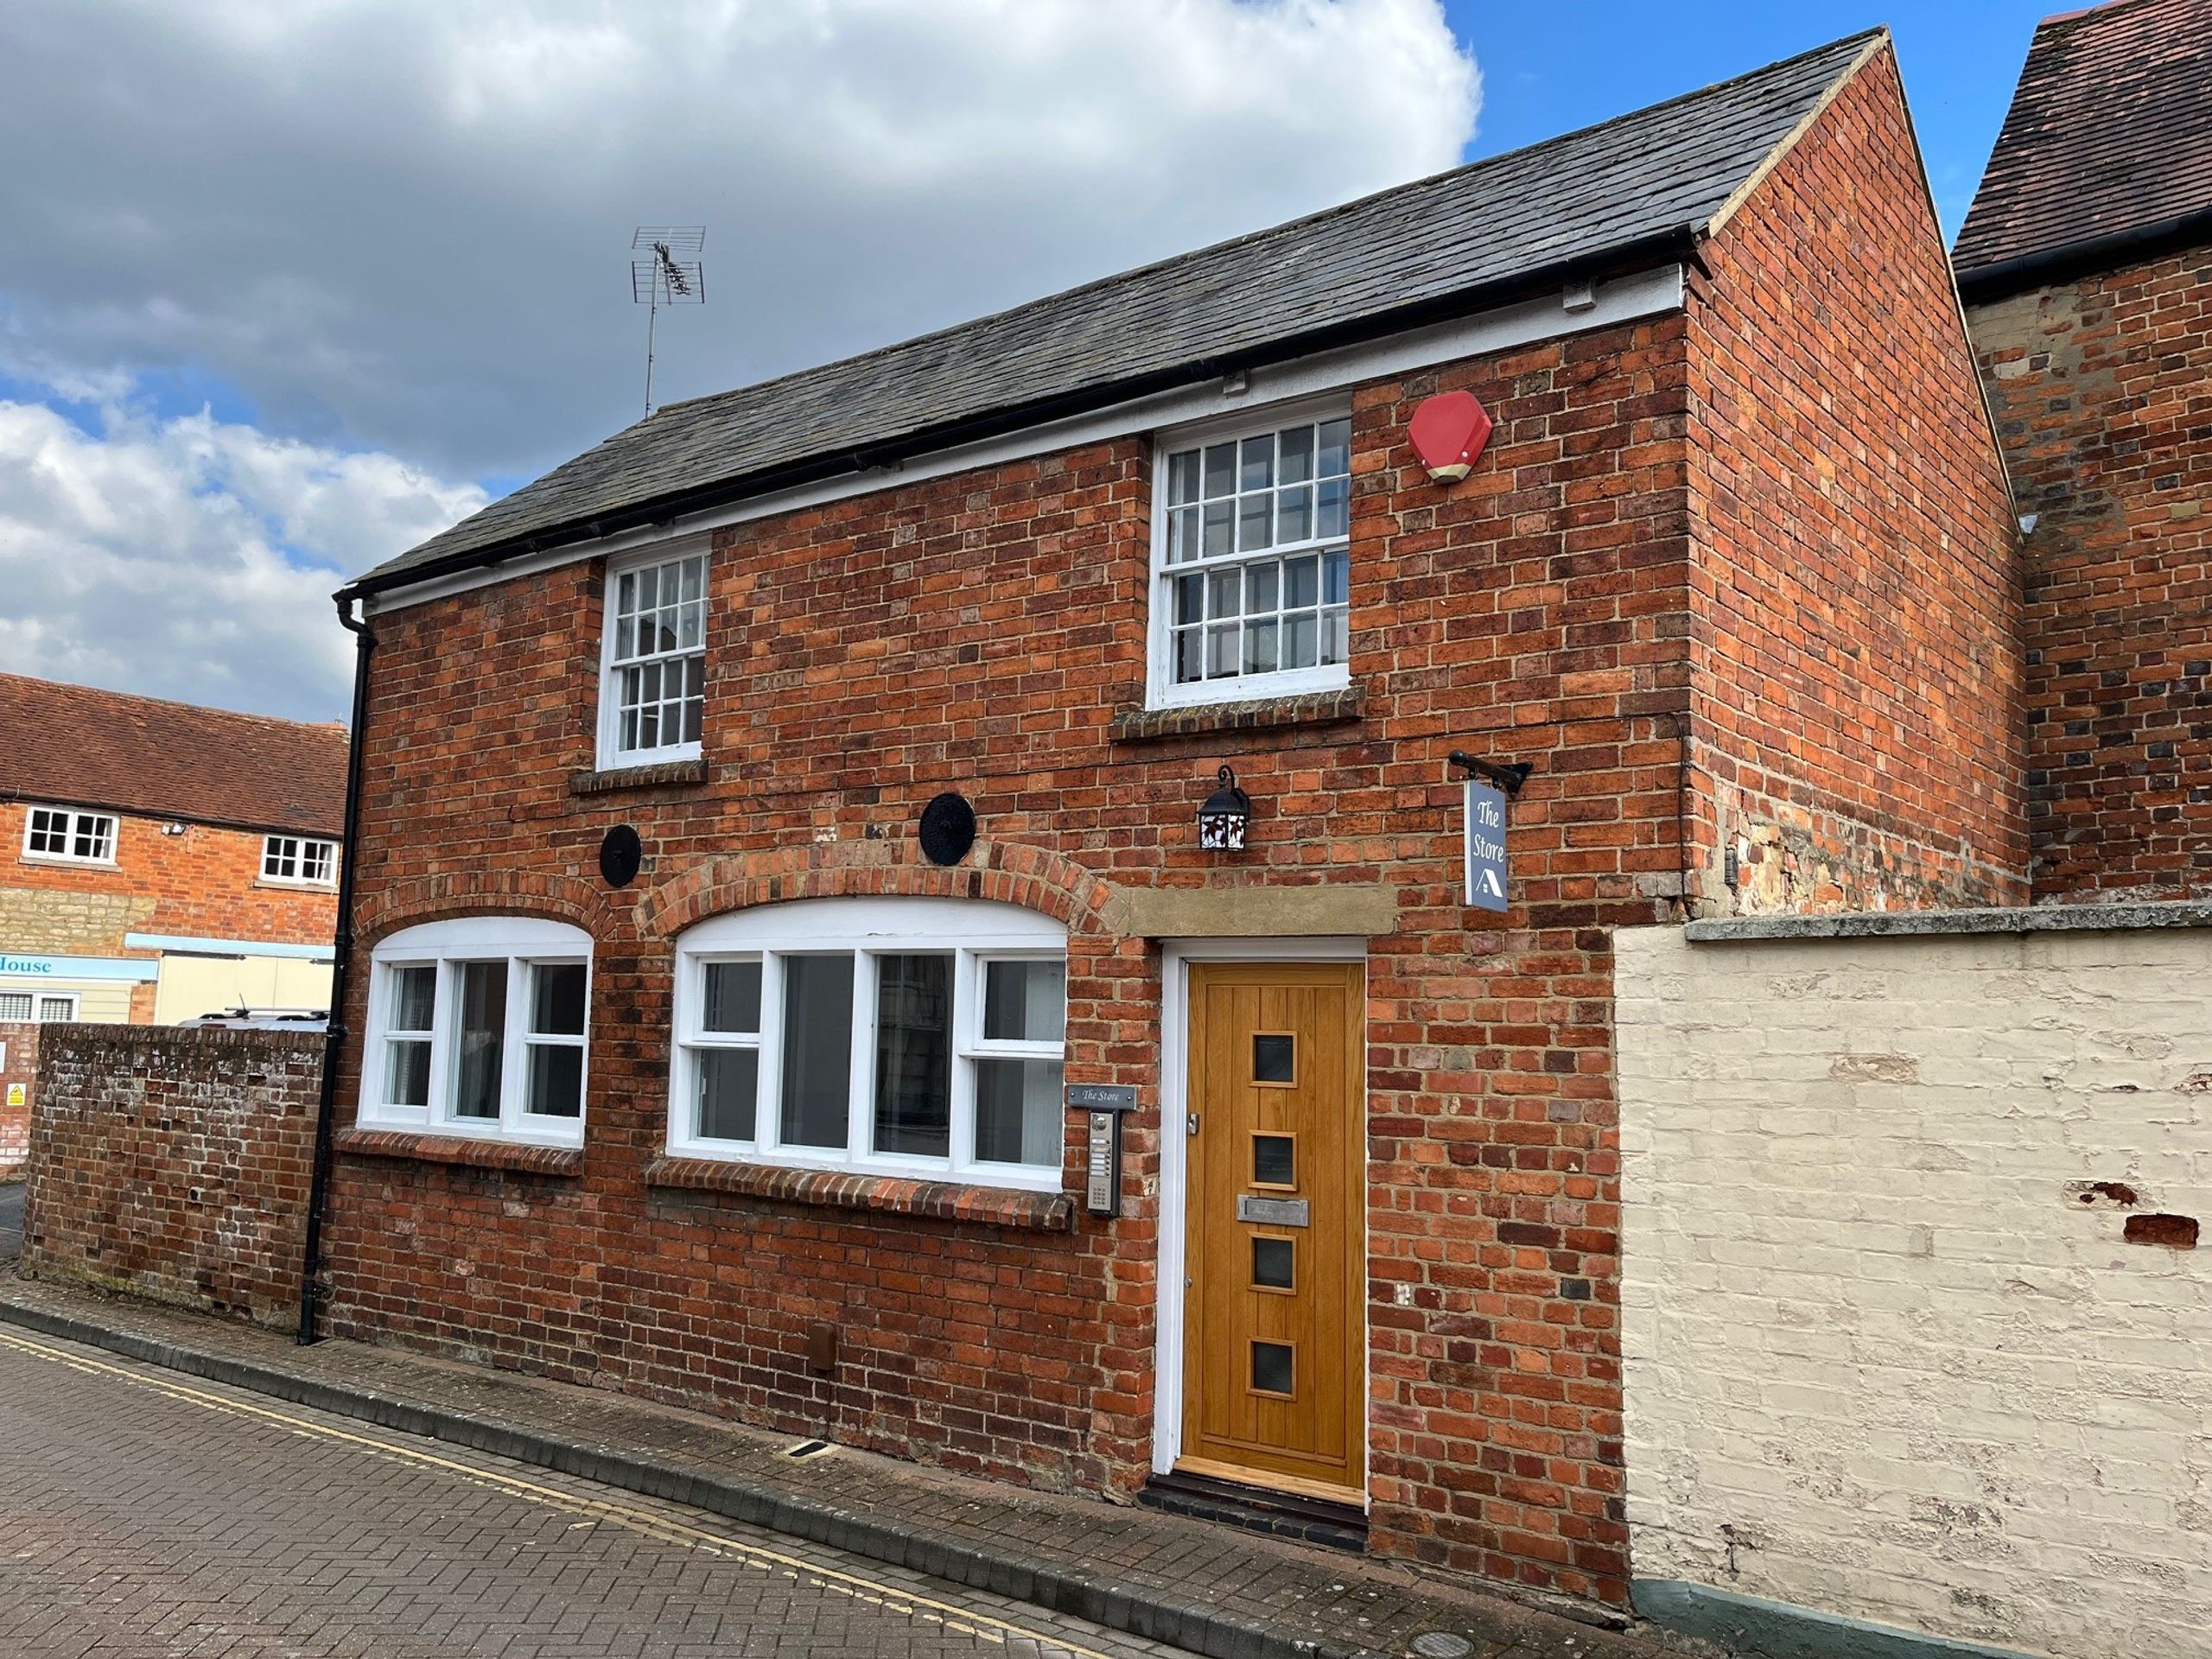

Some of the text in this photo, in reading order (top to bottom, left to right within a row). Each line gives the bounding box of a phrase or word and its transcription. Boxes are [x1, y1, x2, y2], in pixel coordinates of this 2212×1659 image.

[1477, 800, 1499, 829] The
[1473, 833, 1504, 863] Store
[1082, 1090, 1120, 1102] The Store
